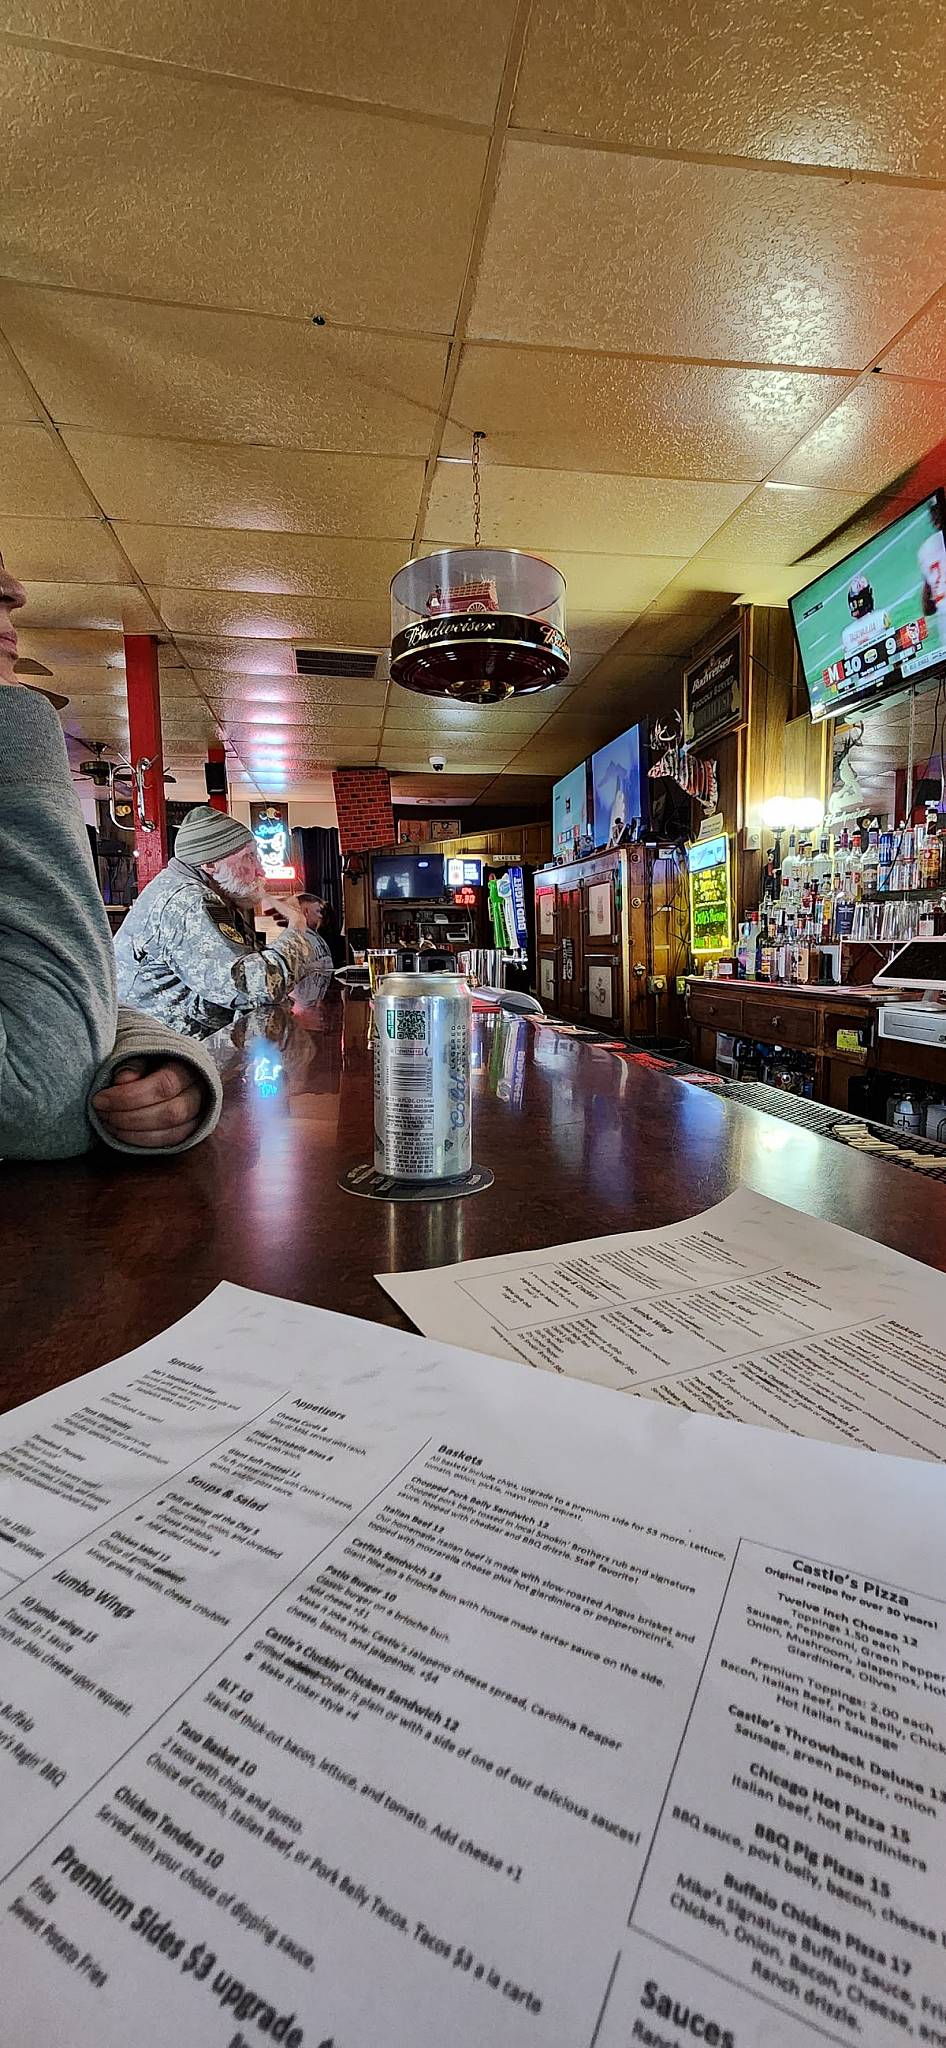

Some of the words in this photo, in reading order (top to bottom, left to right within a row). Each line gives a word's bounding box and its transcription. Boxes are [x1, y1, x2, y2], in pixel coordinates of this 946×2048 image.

[404, 618, 497, 648] Budweiser
[885, 637, 897, 655] 9
[844, 656, 862, 677] 10
[513, 876, 525, 907] LIGHT
[515, 907, 526, 931] BUD
[290, 1398, 346, 1420] Appetizers
[437, 1444, 483, 1466] Baskets
[186, 1475, 223, 1495] Soups
[218, 1488, 235, 1499] &
[232, 1493, 269, 1512] Salad
[382, 1504, 411, 1521] Italian
[410, 1515, 434, 1529] Beef
[431, 1523, 445, 1534] 12
[407, 1476, 449, 1495] Chopped
[447, 1488, 468, 1502] Pork
[469, 1496, 492, 1511] Belly
[491, 1504, 536, 1525] Sandwich
[536, 1519, 550, 1530] 12
[324, 1564, 351, 1581] Patio
[349, 1575, 384, 1595] Burger
[381, 1591, 397, 1602] 10
[351, 1536, 383, 1556] Catfish
[381, 1551, 427, 1577] Sandwich
[387, 1519, 436, 1542] homemade
[436, 1537, 464, 1554] Italian
[463, 1548, 486, 1562] beef
[484, 1555, 493, 1566] is
[492, 1560, 519, 1575] made
[520, 1570, 540, 1584] with
[603, 1602, 635, 1620] Angus
[637, 1613, 673, 1635] brisket
[674, 1630, 696, 1644] and
[792, 1559, 858, 1590] Castle's
[863, 1581, 909, 1607] Pizza
[51, 1569, 97, 1598] Jumbo
[93, 1588, 135, 1619] Wings
[764, 1566, 804, 1585] Original
[806, 1580, 838, 1596] recipe
[840, 1590, 857, 1602] for
[858, 1598, 883, 1612] over
[886, 1606, 901, 1617] 30
[903, 1612, 938, 1630] years!
[777, 1592, 820, 1613] Twelve
[822, 1606, 849, 1624] Inch
[852, 1617, 898, 1641] Cheese
[902, 1634, 918, 1648] 12
[745, 1605, 793, 1629] Sausage,
[796, 1621, 857, 1653] Pepperoni,
[860, 1645, 898, 1667] Green
[901, 1659, 946, 1683] Pepper
[746, 1617, 782, 1638] Onion,
[785, 1630, 853, 1664] Mushroom,
[855, 1656, 920, 1690] Jalapenos,
[923, 1680, 946, 1697] Hot
[791, 1608, 841, 1633] Toppings
[844, 1626, 869, 1643] 1.50
[871, 1638, 900, 1656] each
[215, 1677, 240, 1695] BLT
[235, 1688, 254, 1704] 10
[264, 1626, 303, 1652] Castle's
[343, 1667, 386, 1696] Chicken
[385, 1689, 442, 1725] Sandwich
[442, 1716, 460, 1733] 12
[750, 1656, 804, 1684] Premium
[807, 1676, 866, 1708] Toppings:
[870, 1701, 899, 1721] 2.00
[902, 1715, 934, 1735] each
[787, 1644, 855, 1678] Giardiniera,
[858, 1671, 897, 1693] Olives
[720, 1658, 758, 1682] Bacon,
[761, 1673, 799, 1696] Italian
[802, 1688, 834, 1711] Beef,
[837, 1702, 866, 1723] Pork
[870, 1715, 906, 1741] Belly,
[776, 1693, 799, 1711] Hot
[801, 1703, 841, 1728] Italian
[844, 1720, 898, 1751] Sausage
[176, 1719, 204, 1744] Taco
[201, 1735, 240, 1768] Basket
[238, 1760, 257, 1777] 10
[728, 1704, 781, 1734] Castle's
[784, 1725, 865, 1770] Throwback
[869, 1761, 924, 1795] Deluxe
[734, 1722, 790, 1756] Sausage,
[792, 1748, 832, 1773] green
[835, 1766, 889, 1799] pepper,
[893, 1792, 936, 1818] onion
[731, 1773, 774, 1803] Italian
[777, 1792, 812, 1822] beef,
[816, 1810, 841, 1834] hot
[844, 1826, 927, 1873] giardiniera
[749, 1762, 808, 1798] Chicago
[812, 1788, 841, 1814] Hot
[844, 1804, 885, 1833] Pizza
[113, 1785, 159, 1824] Chicken
[156, 1813, 205, 1858] Tenders
[202, 1848, 224, 1870] 10
[754, 1822, 790, 1853] BBQ
[793, 1840, 819, 1867] Pig
[822, 1853, 865, 1886] Pizza
[51, 1844, 135, 1920] Premium
[130, 1905, 186, 1960] Sides
[181, 1942, 217, 1981] $3
[211, 1969, 303, 2048] upgrade
[723, 1872, 778, 1911] Buffalo
[781, 1901, 841, 1944] Chicken
[845, 1932, 886, 1966] Pizza
[890, 1955, 912, 1977] 17
[640, 1980, 734, 2048] Sauces
